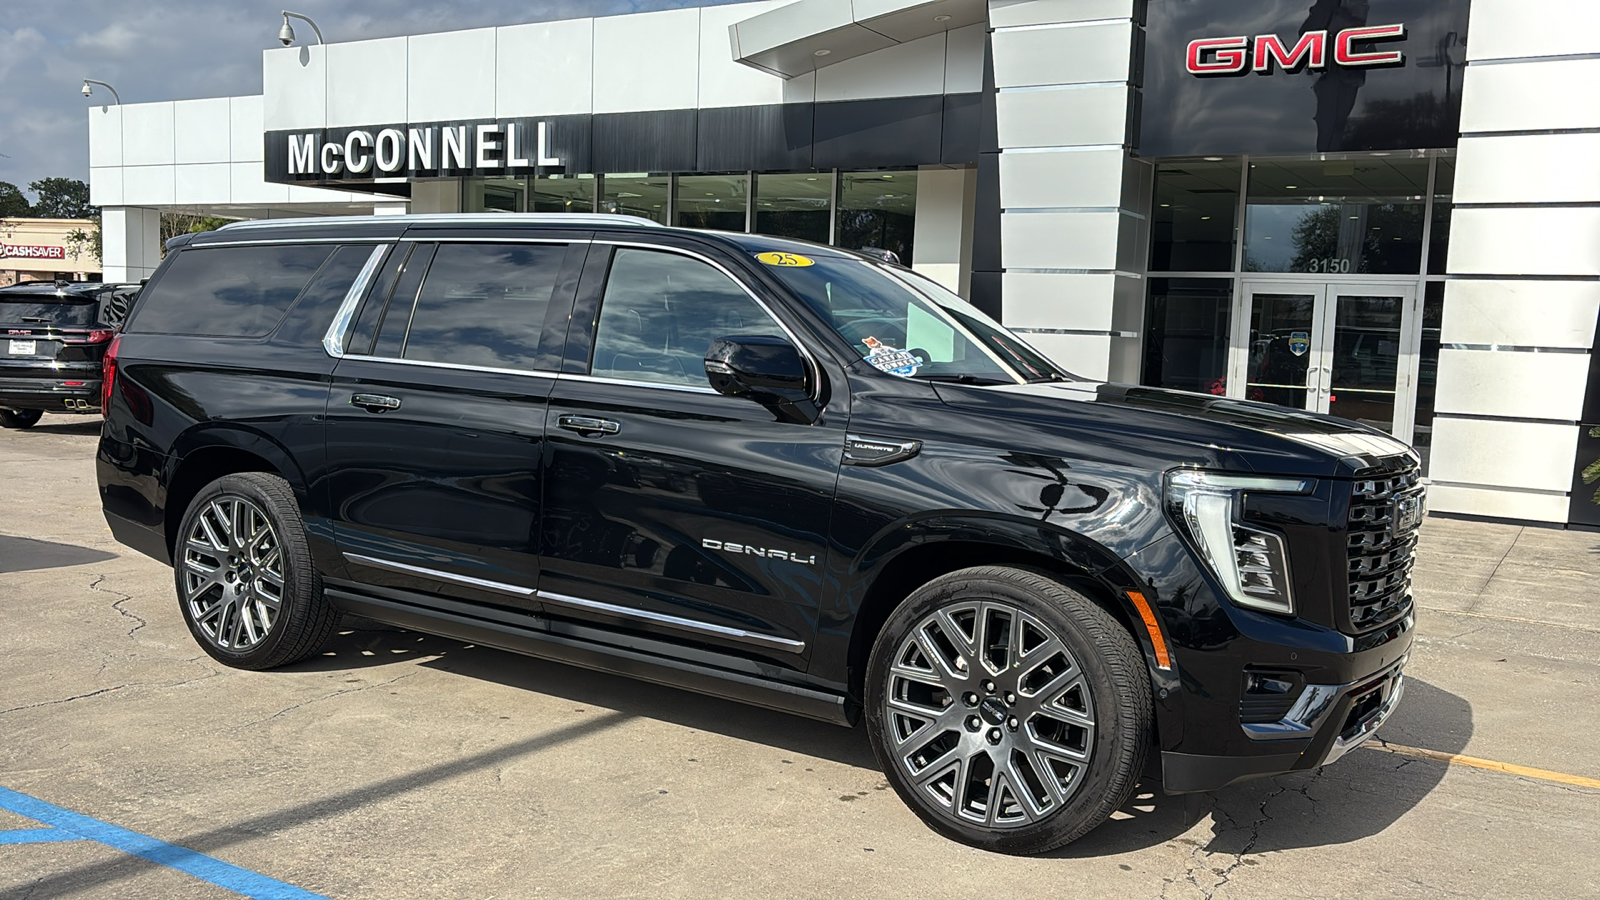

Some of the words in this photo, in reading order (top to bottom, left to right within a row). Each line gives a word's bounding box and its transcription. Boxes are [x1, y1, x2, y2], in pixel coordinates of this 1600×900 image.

[1186, 23, 1404, 74] GMC
[771, 253, 798, 265] 25
[1308, 258, 1350, 274] 3150
[702, 538, 816, 565] DENALI
